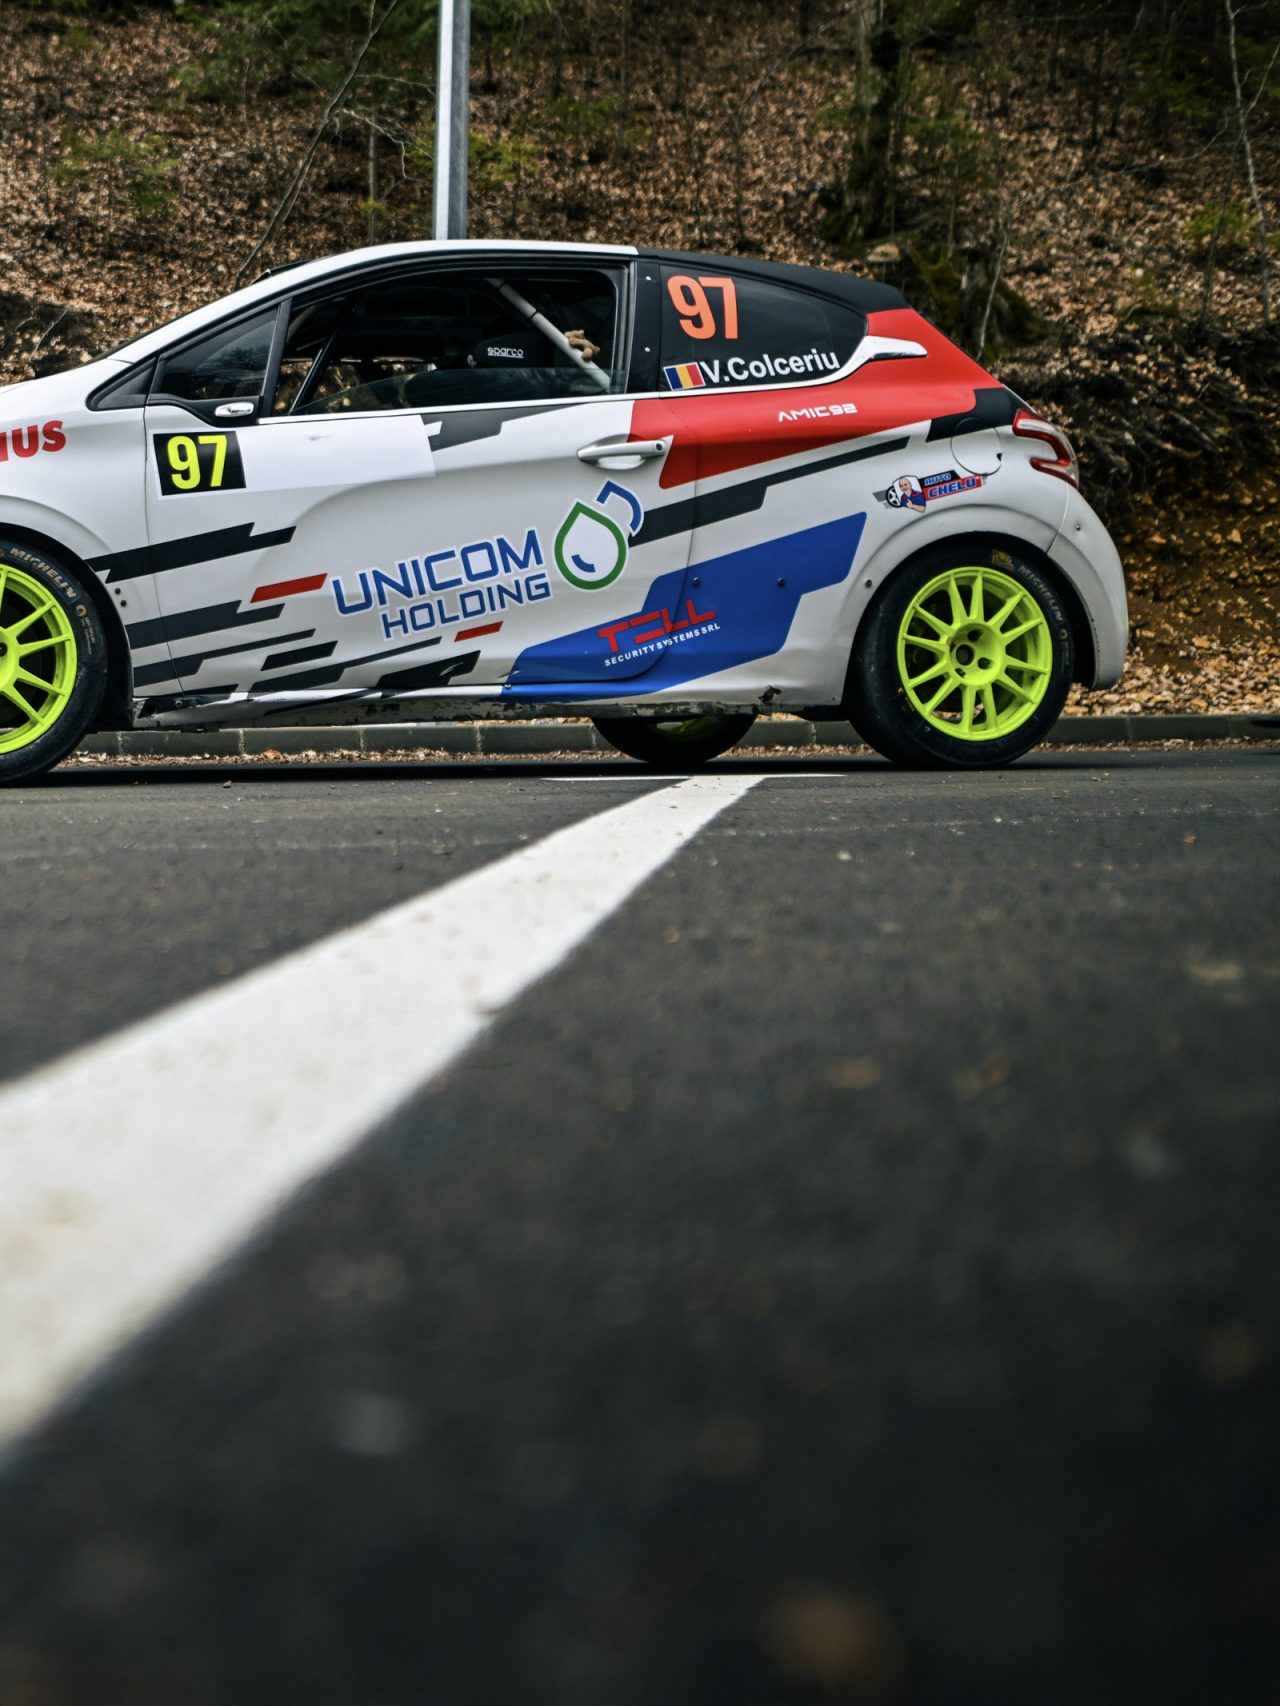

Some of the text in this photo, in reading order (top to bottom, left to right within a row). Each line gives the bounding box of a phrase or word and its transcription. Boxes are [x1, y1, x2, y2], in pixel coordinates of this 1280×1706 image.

[667, 275, 739, 339] 97
[487, 346, 524, 358] sparco
[700, 349, 840, 384] V.Colceriu
[778, 402, 858, 423] AMIC92
[167, 434, 228, 490] 97
[10, 547, 77, 598] MICHELIN
[331, 529, 544, 615] UNICOM
[381, 572, 551, 639] HOLDING
[604, 622, 721, 666] SECURITY SYSTEMS SRL
